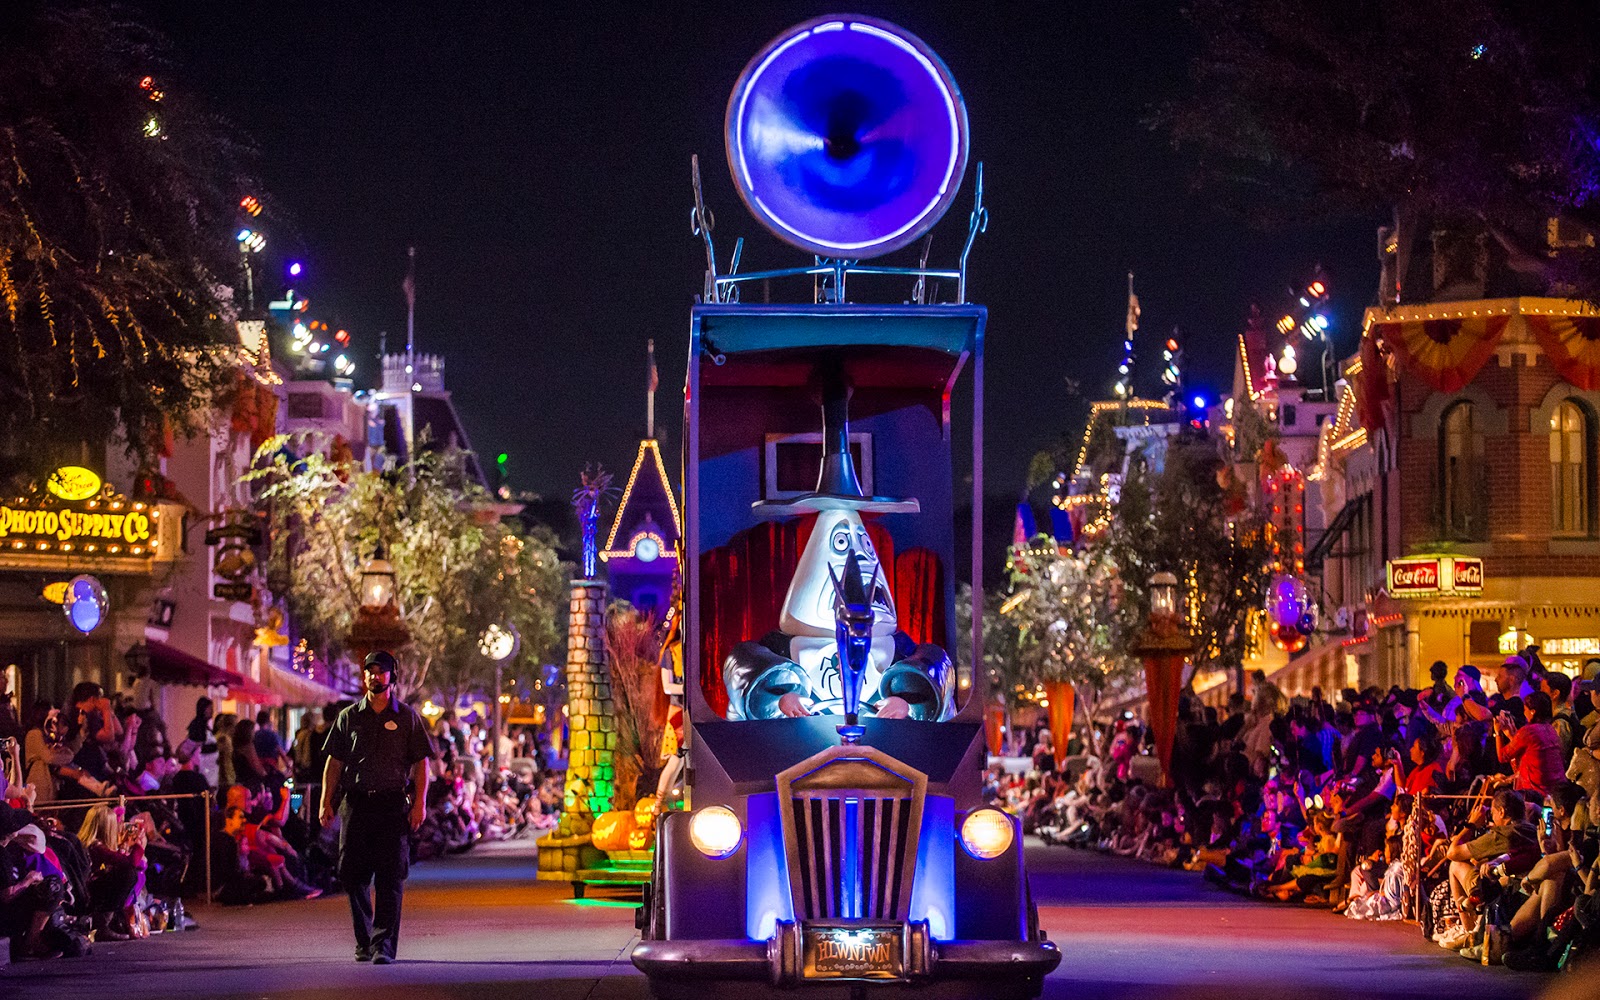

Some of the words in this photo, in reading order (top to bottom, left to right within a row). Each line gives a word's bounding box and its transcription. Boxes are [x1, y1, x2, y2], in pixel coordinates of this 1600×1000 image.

[0, 506, 58, 537] PHOTO
[57, 509, 125, 541] SUPPLY
[817, 940, 891, 962] HLWNTWN
